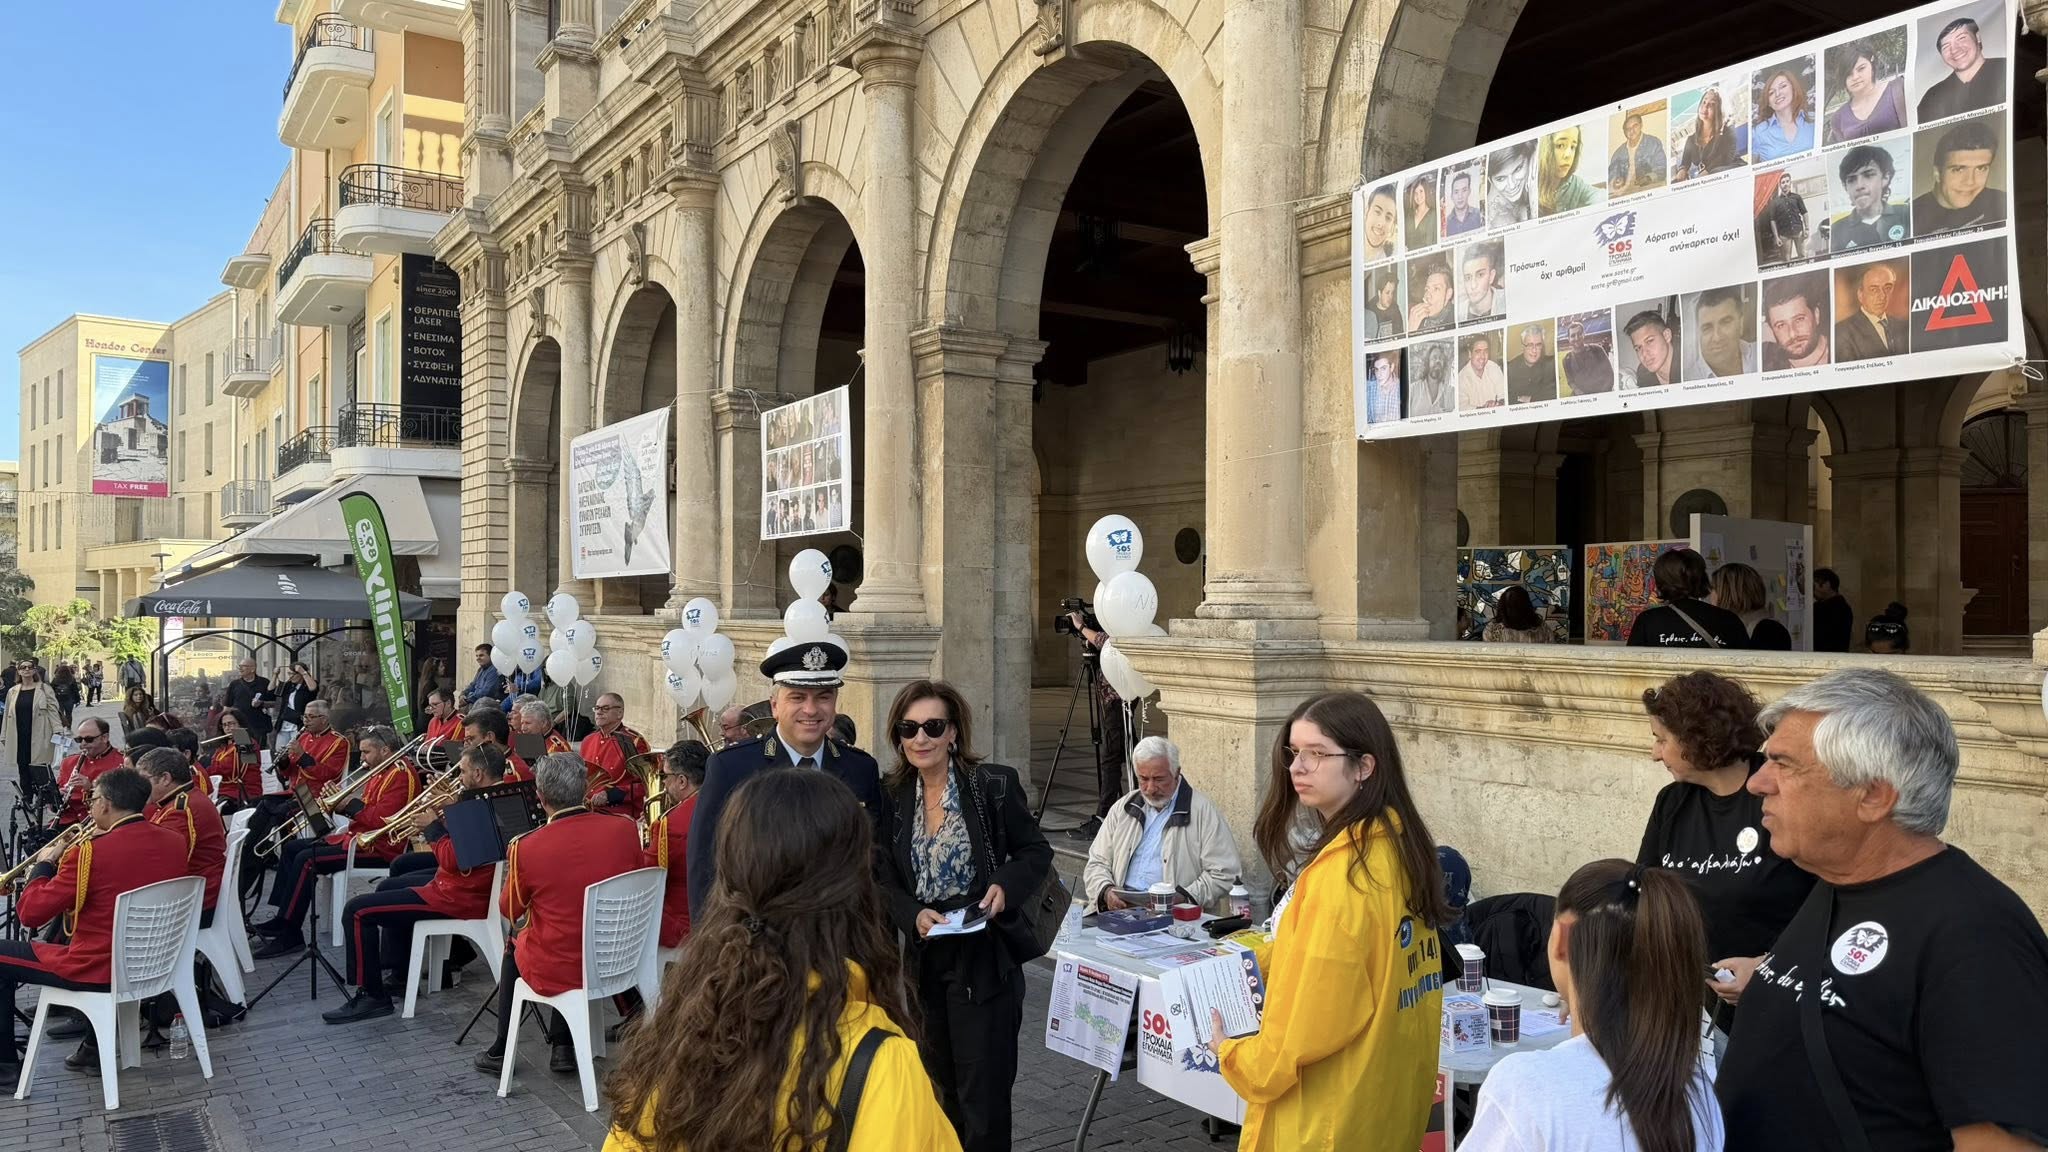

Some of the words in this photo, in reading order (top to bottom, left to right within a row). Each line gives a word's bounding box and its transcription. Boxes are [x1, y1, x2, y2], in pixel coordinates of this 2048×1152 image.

[1645, 228, 1678, 244] Αόρατοι
[1669, 236, 1718, 253] ανύπαρκτοι
[1722, 228, 1740, 243] όχι!
[1608, 239, 1632, 254] SOS
[1509, 259, 1548, 274] Πρόσωπα,
[1540, 270, 1553, 281] όχι
[1556, 263, 1586, 278] αριθμοί!
[416, 286, 436, 294] since
[438, 286, 457, 296] 2000
[1911, 285, 2008, 312] ΔΙΚΑΙΟΣΥΝΗ!
[414, 316, 442, 327] LASER
[413, 332, 455, 344] ΕΝΕΣΙΜΑ
[85, 338, 126, 352] Hondos
[130, 343, 167, 355] Center
[413, 360, 454, 372] ΣΥΣΦΙΞΗ
[113, 482, 128, 490] TAX
[129, 483, 149, 491] FREE
[154, 600, 203, 613] Coca-Cola
[1847, 947, 1868, 963] SOS
[1142, 1031, 1172, 1053] ΤΡΟΧΑΙΑ
[1142, 1041, 1173, 1062] ΕΓΚΛΗΜΑΤΑ
